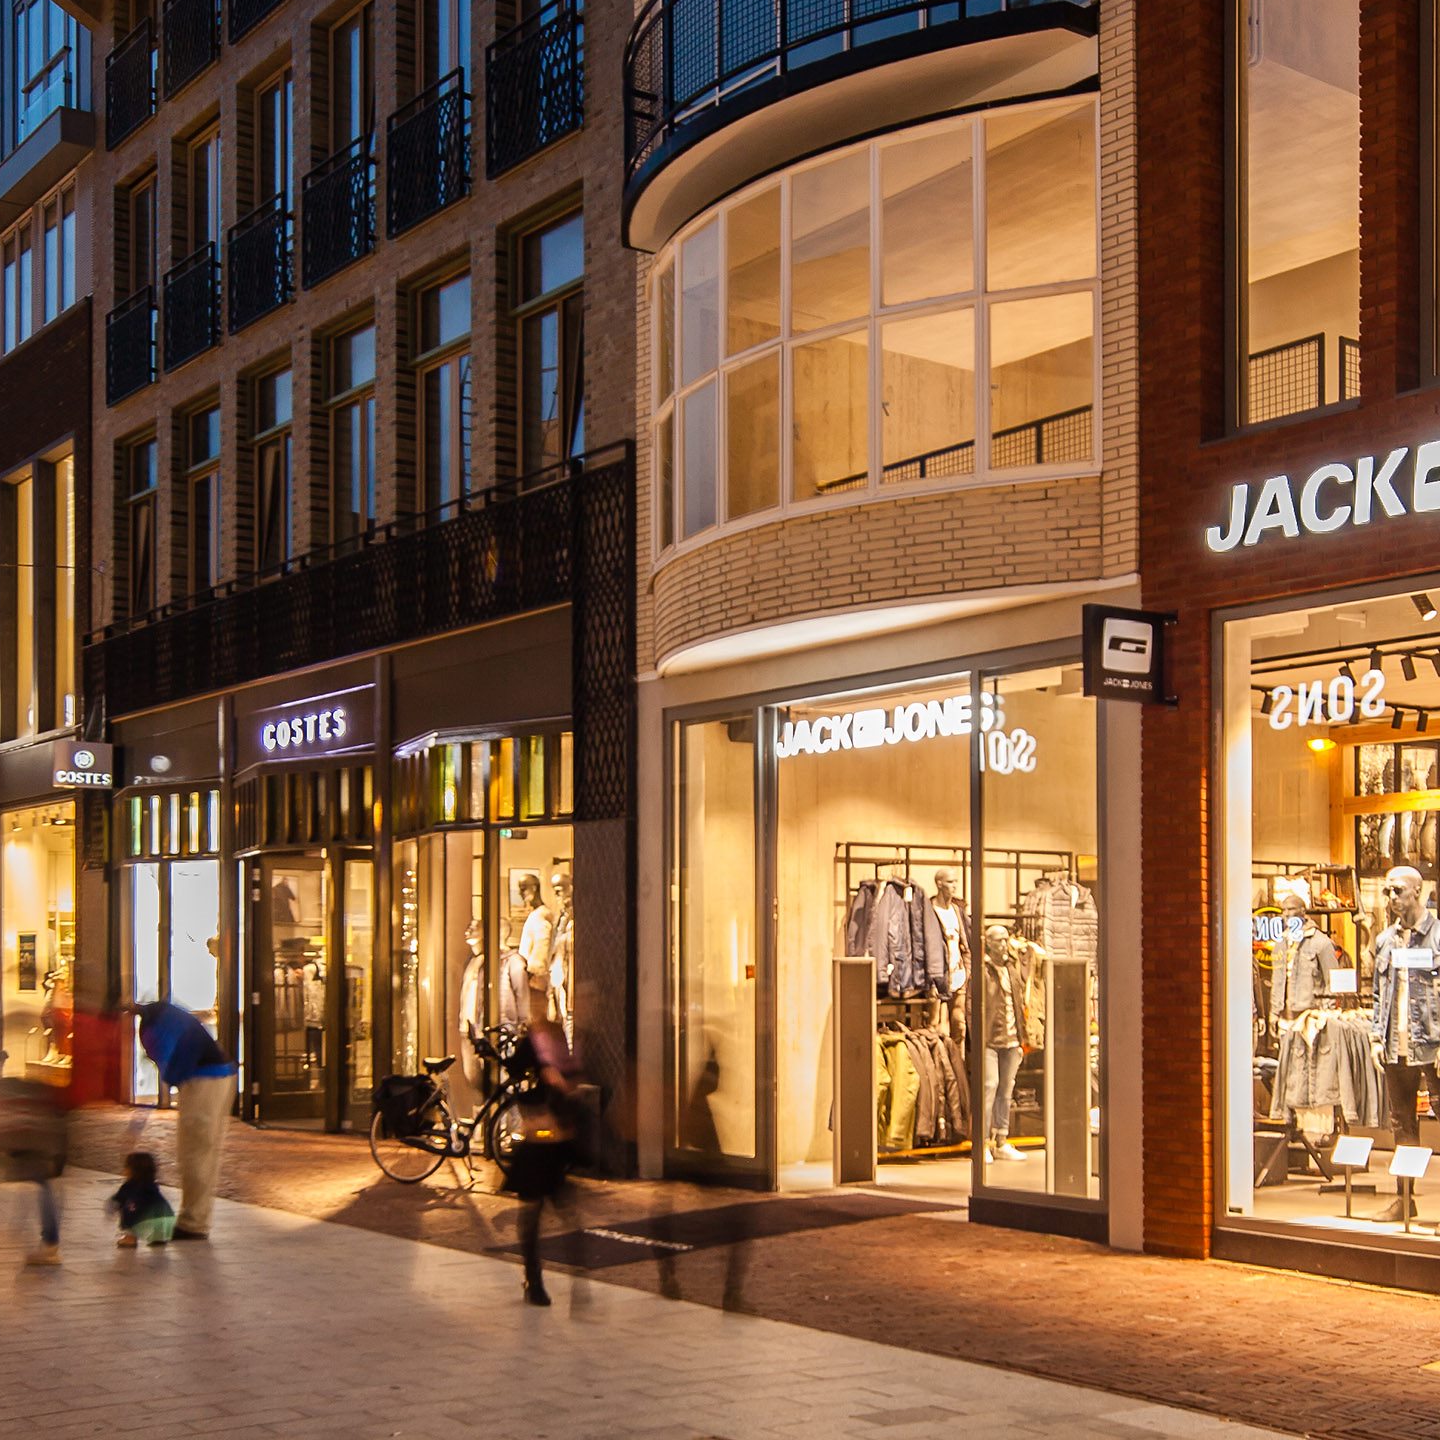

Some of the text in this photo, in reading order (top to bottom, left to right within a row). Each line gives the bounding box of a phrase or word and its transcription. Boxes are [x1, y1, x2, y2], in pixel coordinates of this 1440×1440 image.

[1206, 446, 1410, 553] JACK
[1104, 678, 1153, 690] JACK JONES
[262, 707, 348, 752] COSTES
[776, 713, 854, 759] JACK
[55, 770, 113, 785] COSTES
